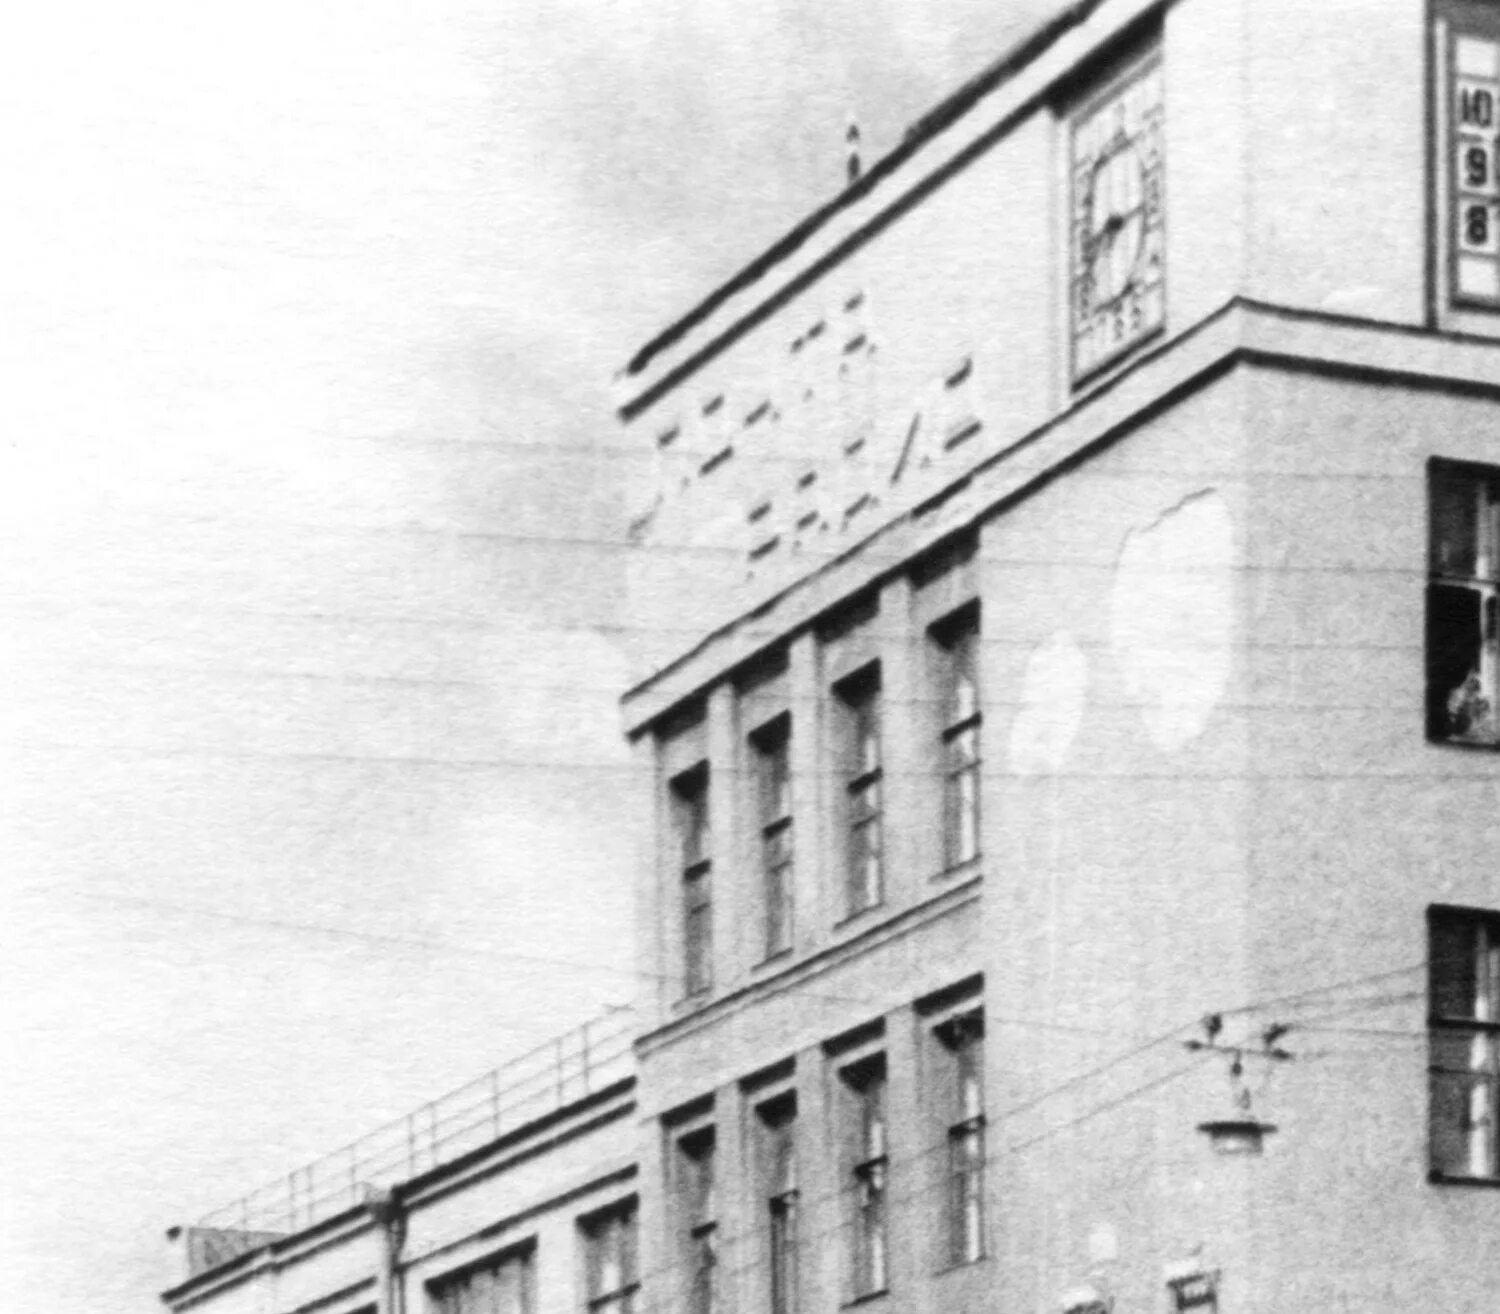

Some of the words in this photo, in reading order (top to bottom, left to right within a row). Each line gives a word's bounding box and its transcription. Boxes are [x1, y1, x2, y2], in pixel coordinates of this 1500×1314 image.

[1461, 87, 1493, 130] 10
[1465, 145, 1489, 189] 9
[1465, 203, 1489, 247] 8
